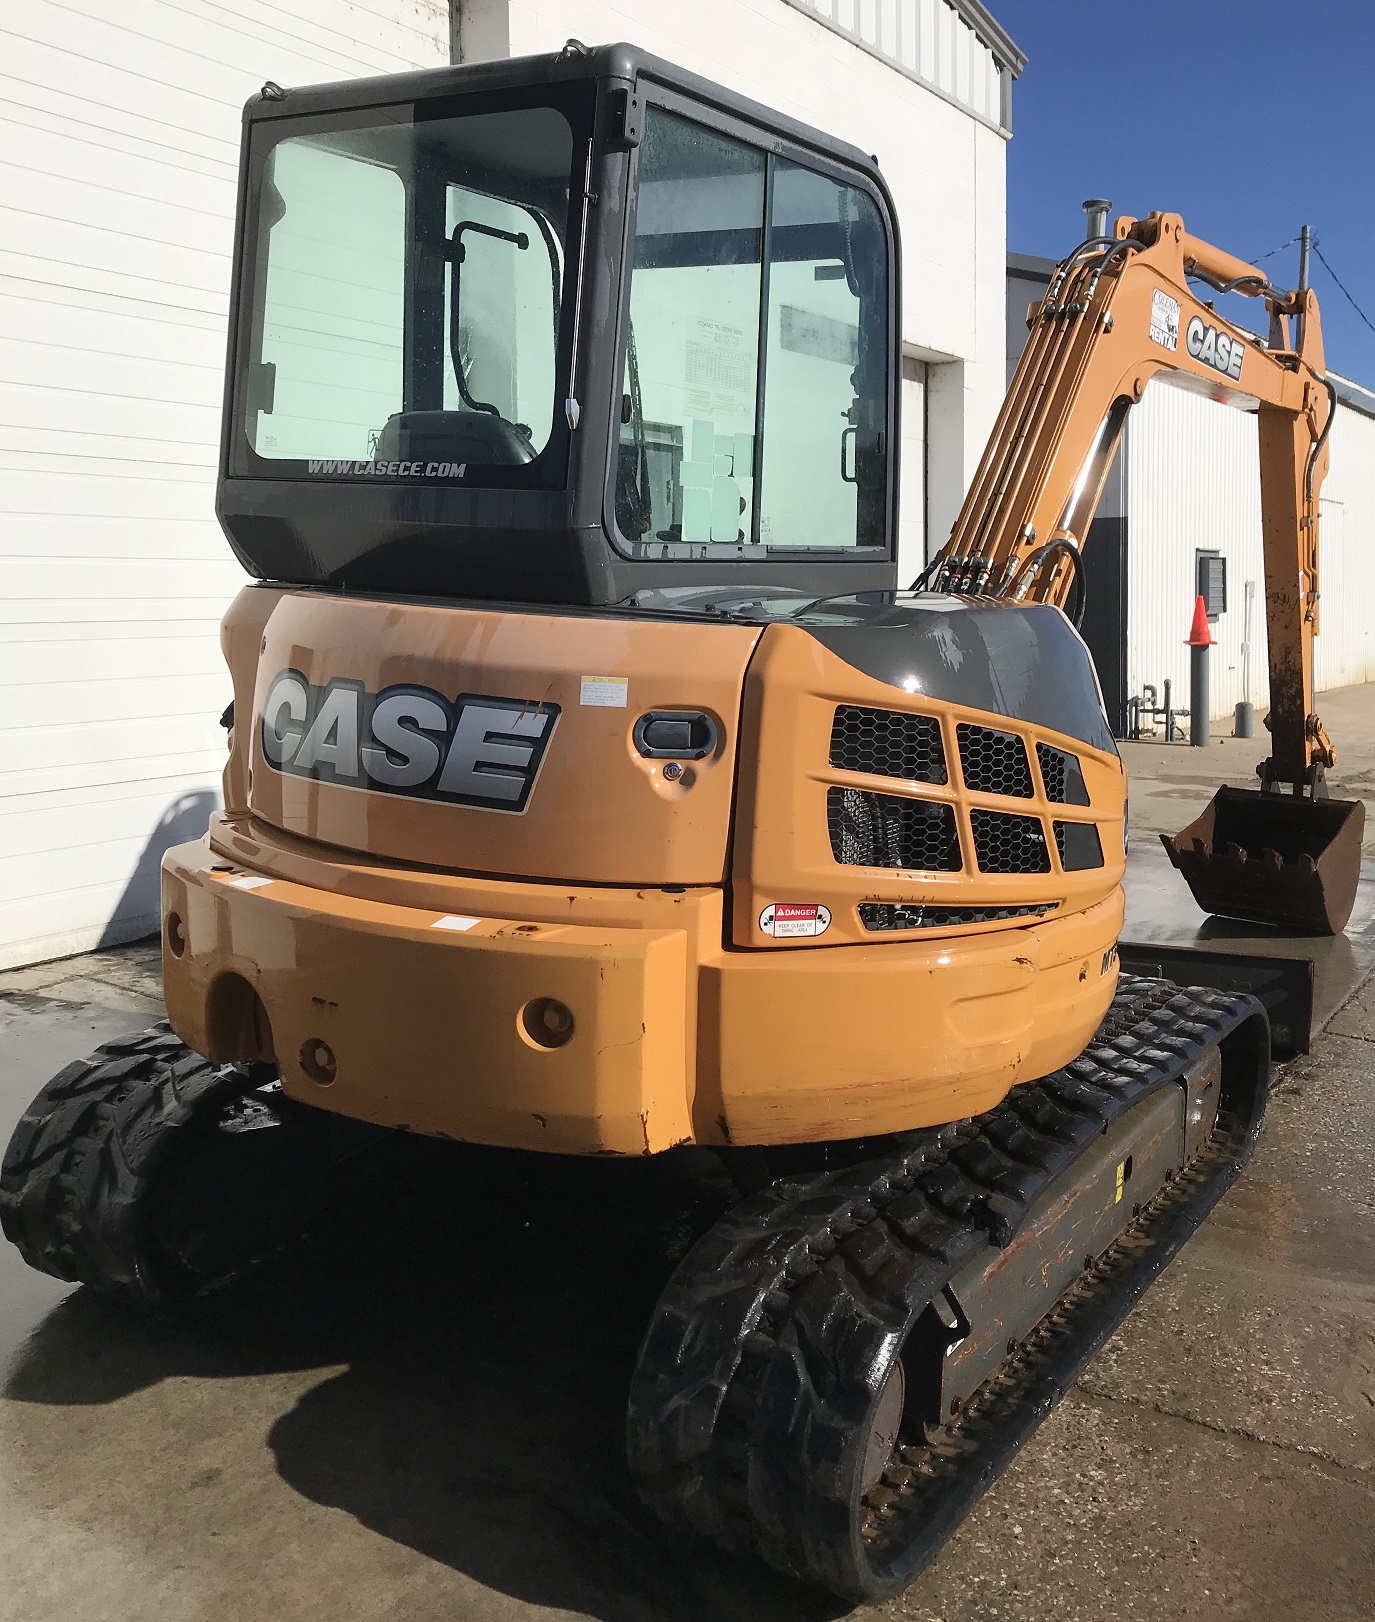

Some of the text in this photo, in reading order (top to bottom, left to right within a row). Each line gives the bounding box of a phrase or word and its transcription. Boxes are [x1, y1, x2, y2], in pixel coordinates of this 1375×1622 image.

[1150, 325, 1177, 350] RENTAL
[1187, 317, 1245, 381] CASE
[308, 460, 467, 478] WWW.CASECE.COM
[263, 677, 550, 801] CASE
